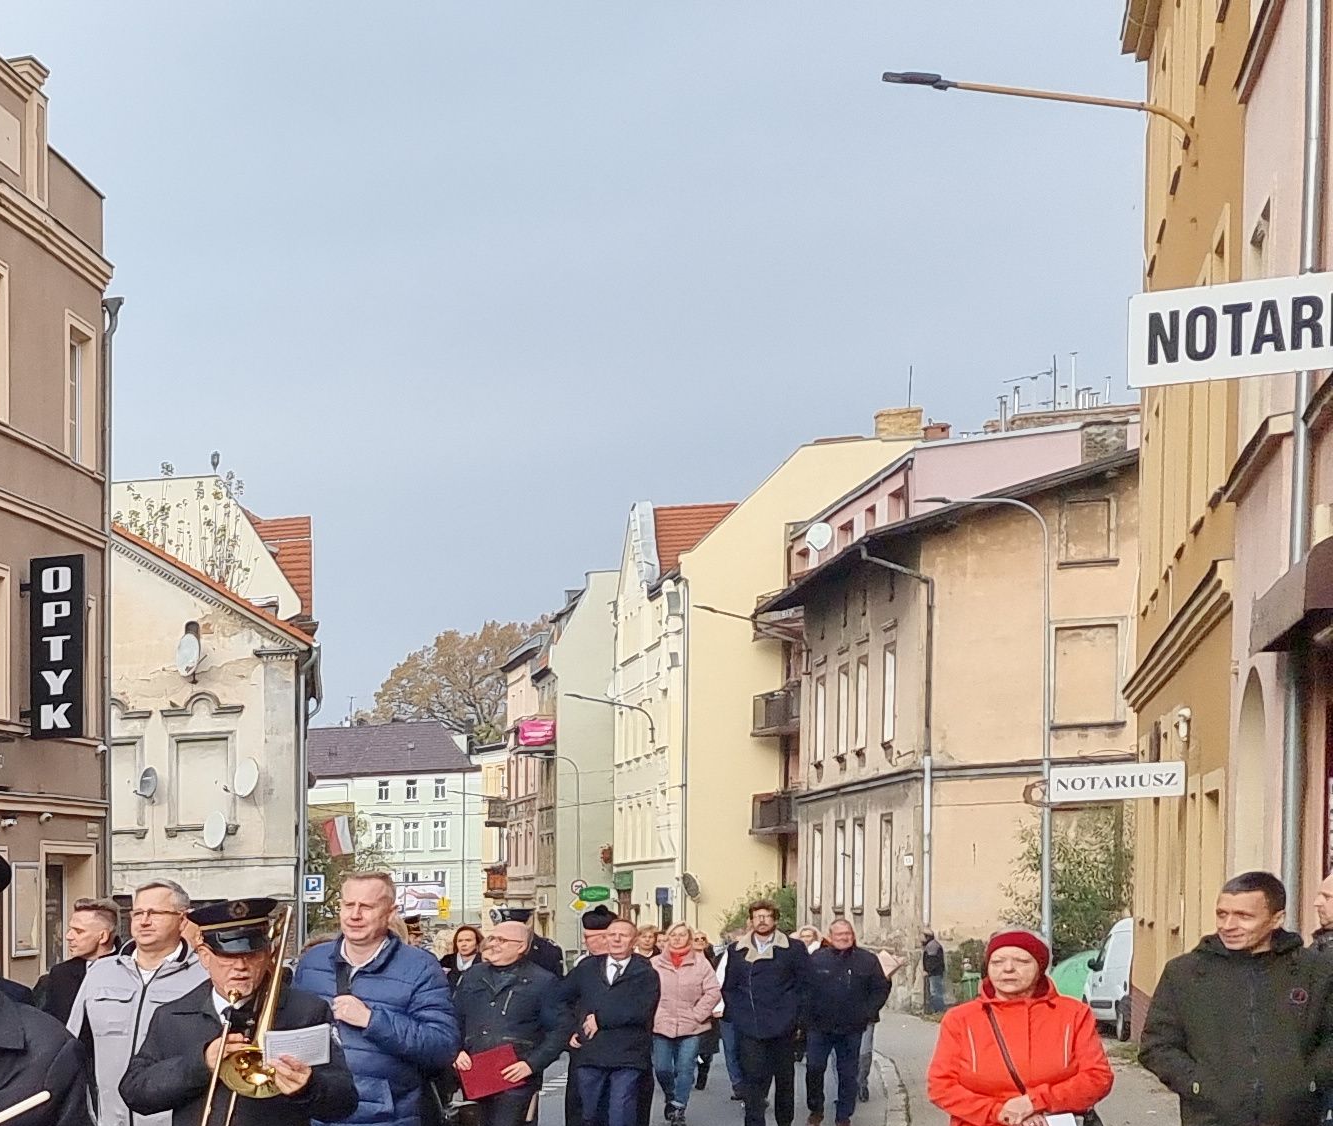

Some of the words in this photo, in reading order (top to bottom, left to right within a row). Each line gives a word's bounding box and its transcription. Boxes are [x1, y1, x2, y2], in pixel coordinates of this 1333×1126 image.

[1148, 293, 1333, 365] NOTAR
[40, 566, 73, 730] OPTYK
[1056, 772, 1178, 791] NOTARIUSZ
